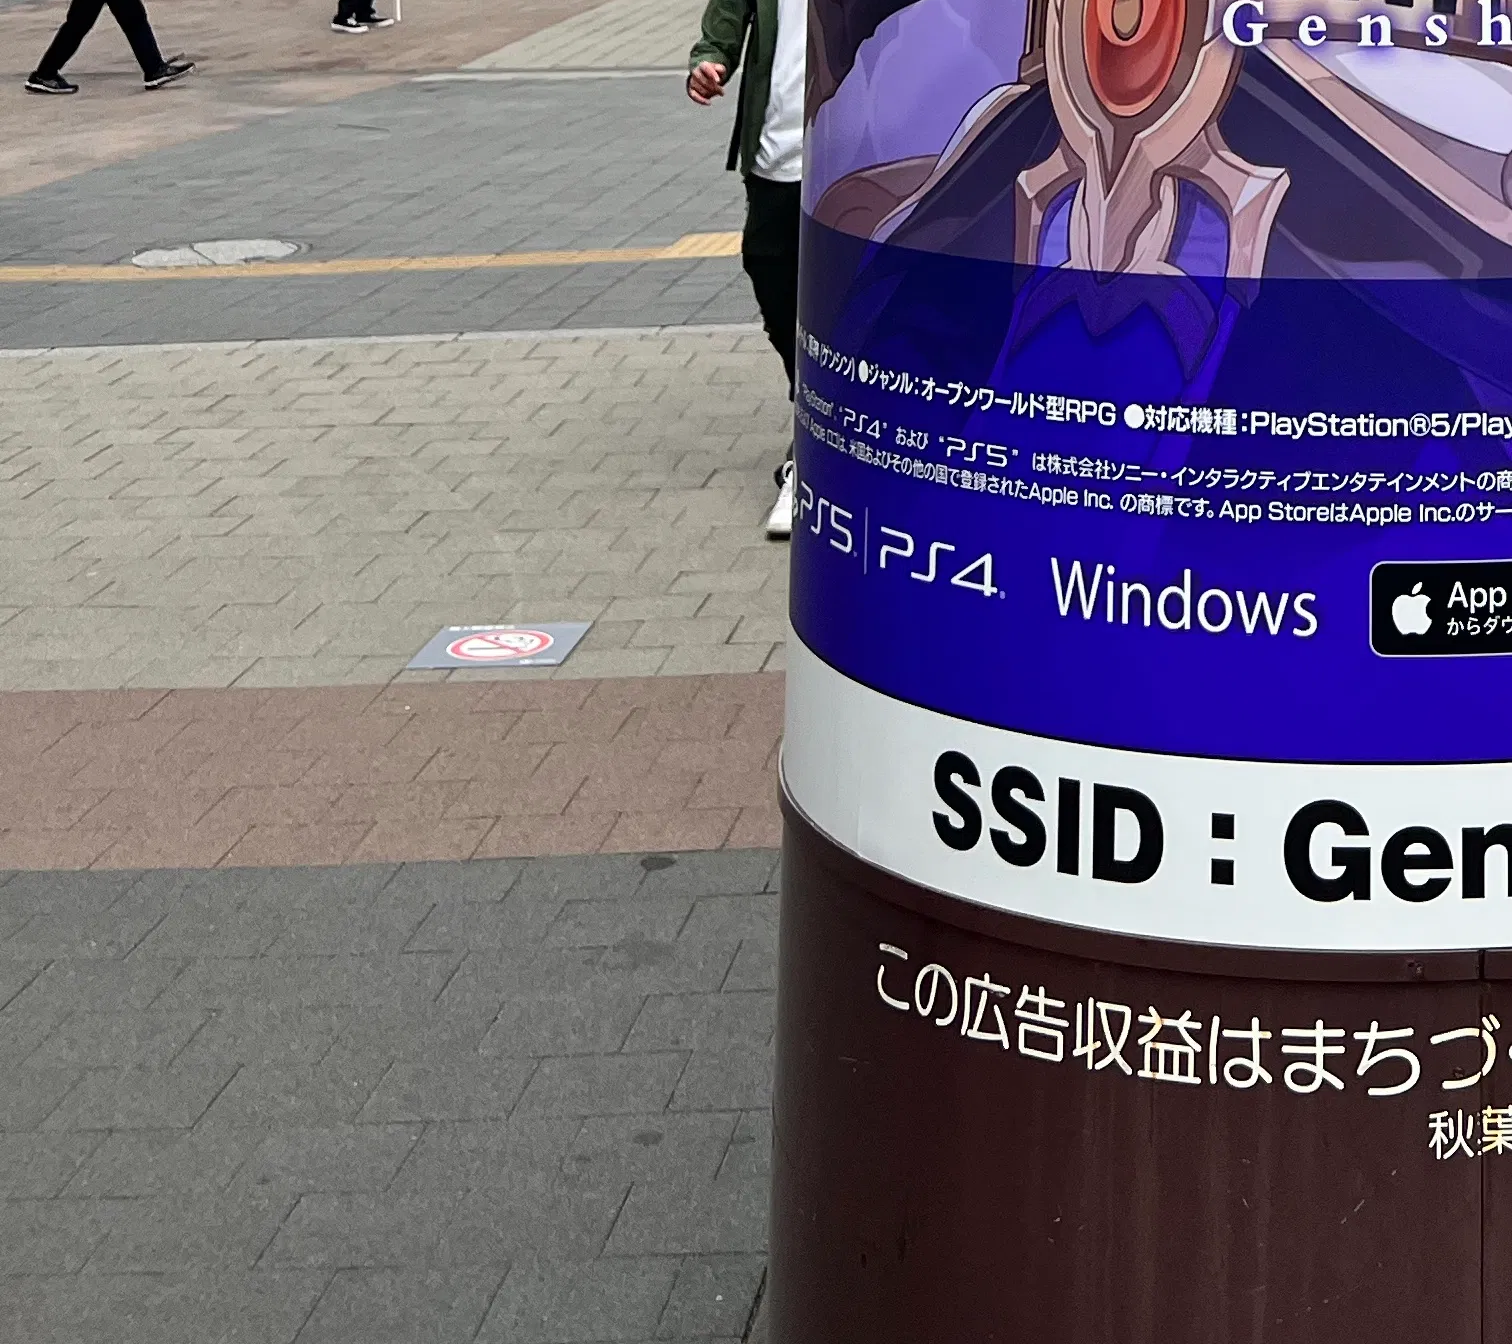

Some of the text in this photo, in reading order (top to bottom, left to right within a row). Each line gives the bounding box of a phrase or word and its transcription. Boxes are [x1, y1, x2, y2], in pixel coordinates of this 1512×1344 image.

[895, 426, 929, 450] および
[879, 525, 1006, 600] PS4
[1050, 556, 1319, 637] Windows
[1447, 582, 1507, 616] App
[931, 749, 1165, 884] SSID
